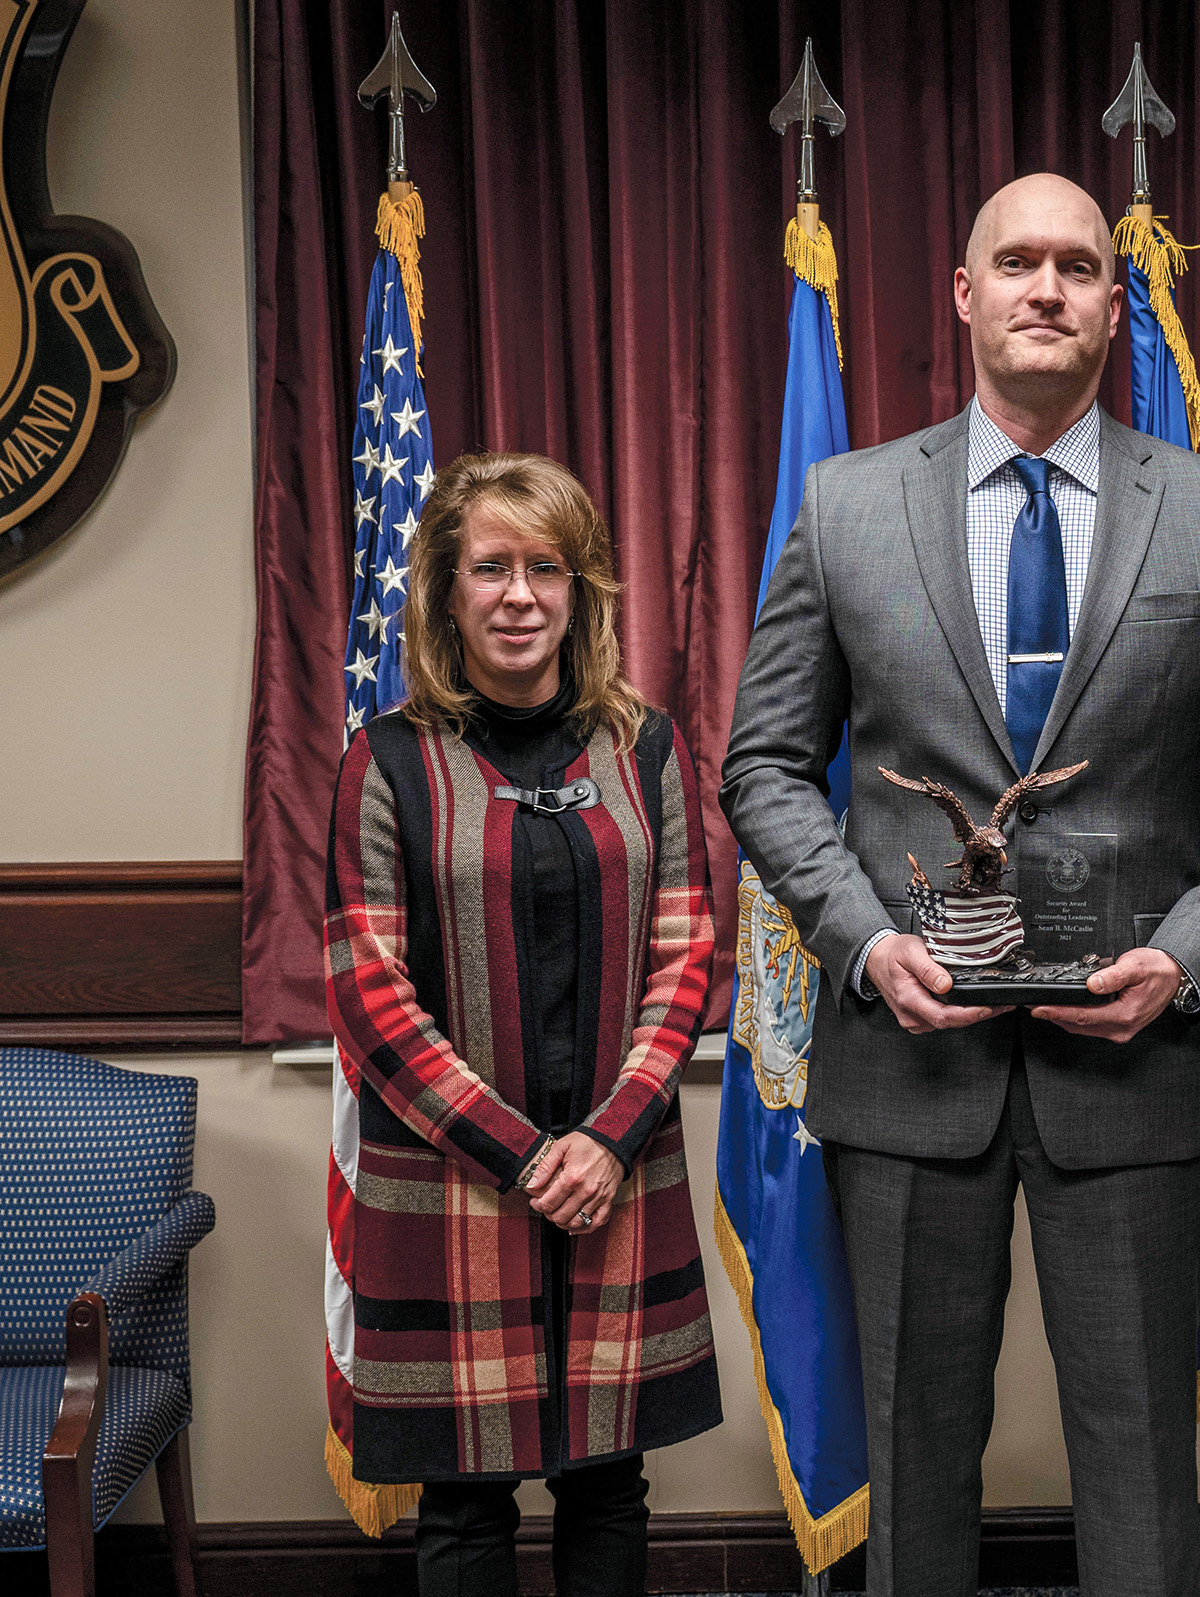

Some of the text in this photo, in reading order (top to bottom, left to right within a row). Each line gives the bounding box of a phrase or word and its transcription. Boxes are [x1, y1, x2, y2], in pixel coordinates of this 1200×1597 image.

[0, 385, 76, 499] MAND
[740, 887, 759, 966] UNITED
[1034, 913, 1097, 922] Outstanding Leadership
